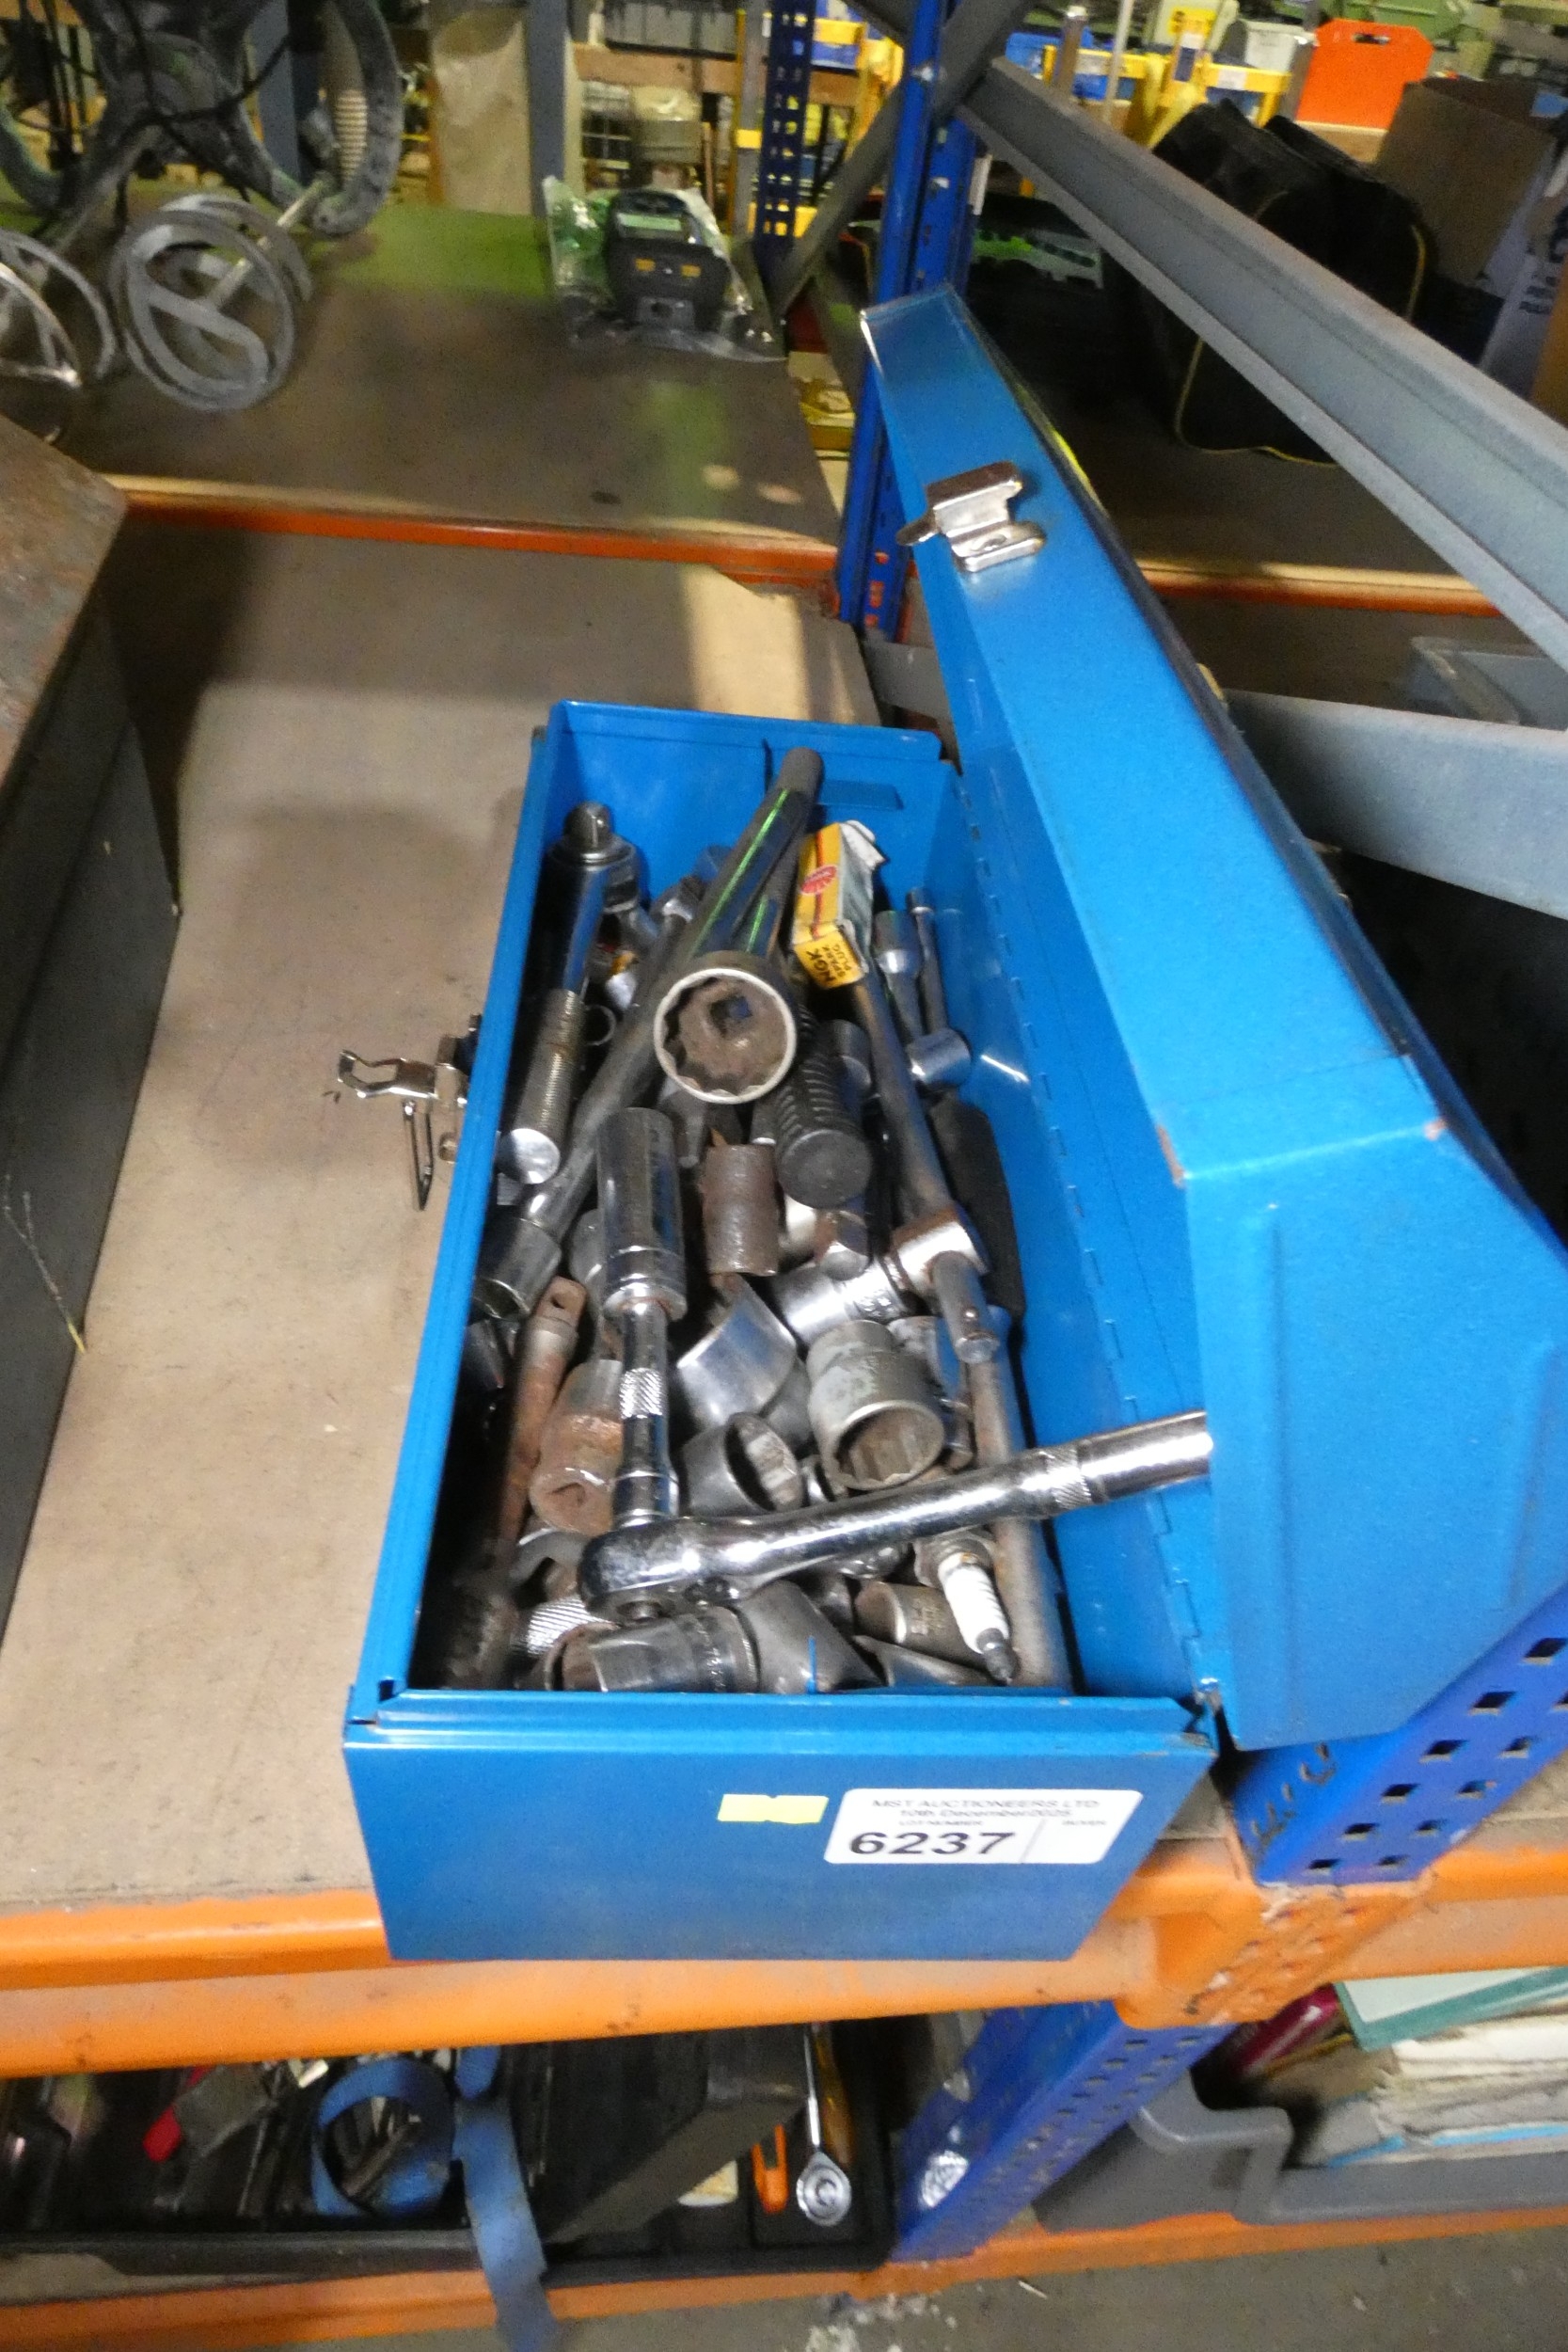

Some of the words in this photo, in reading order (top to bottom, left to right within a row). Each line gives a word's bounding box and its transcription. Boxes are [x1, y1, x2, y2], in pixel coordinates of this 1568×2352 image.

[805, 948, 836, 981] NGK
[822, 945, 846, 977] SPARK
[832, 944, 851, 970] PLUG
[918, 1800, 1057, 1808] AUCTIONEERS
[1063, 1800, 1100, 1808] LTD
[849, 1832, 1015, 1854] 6237
